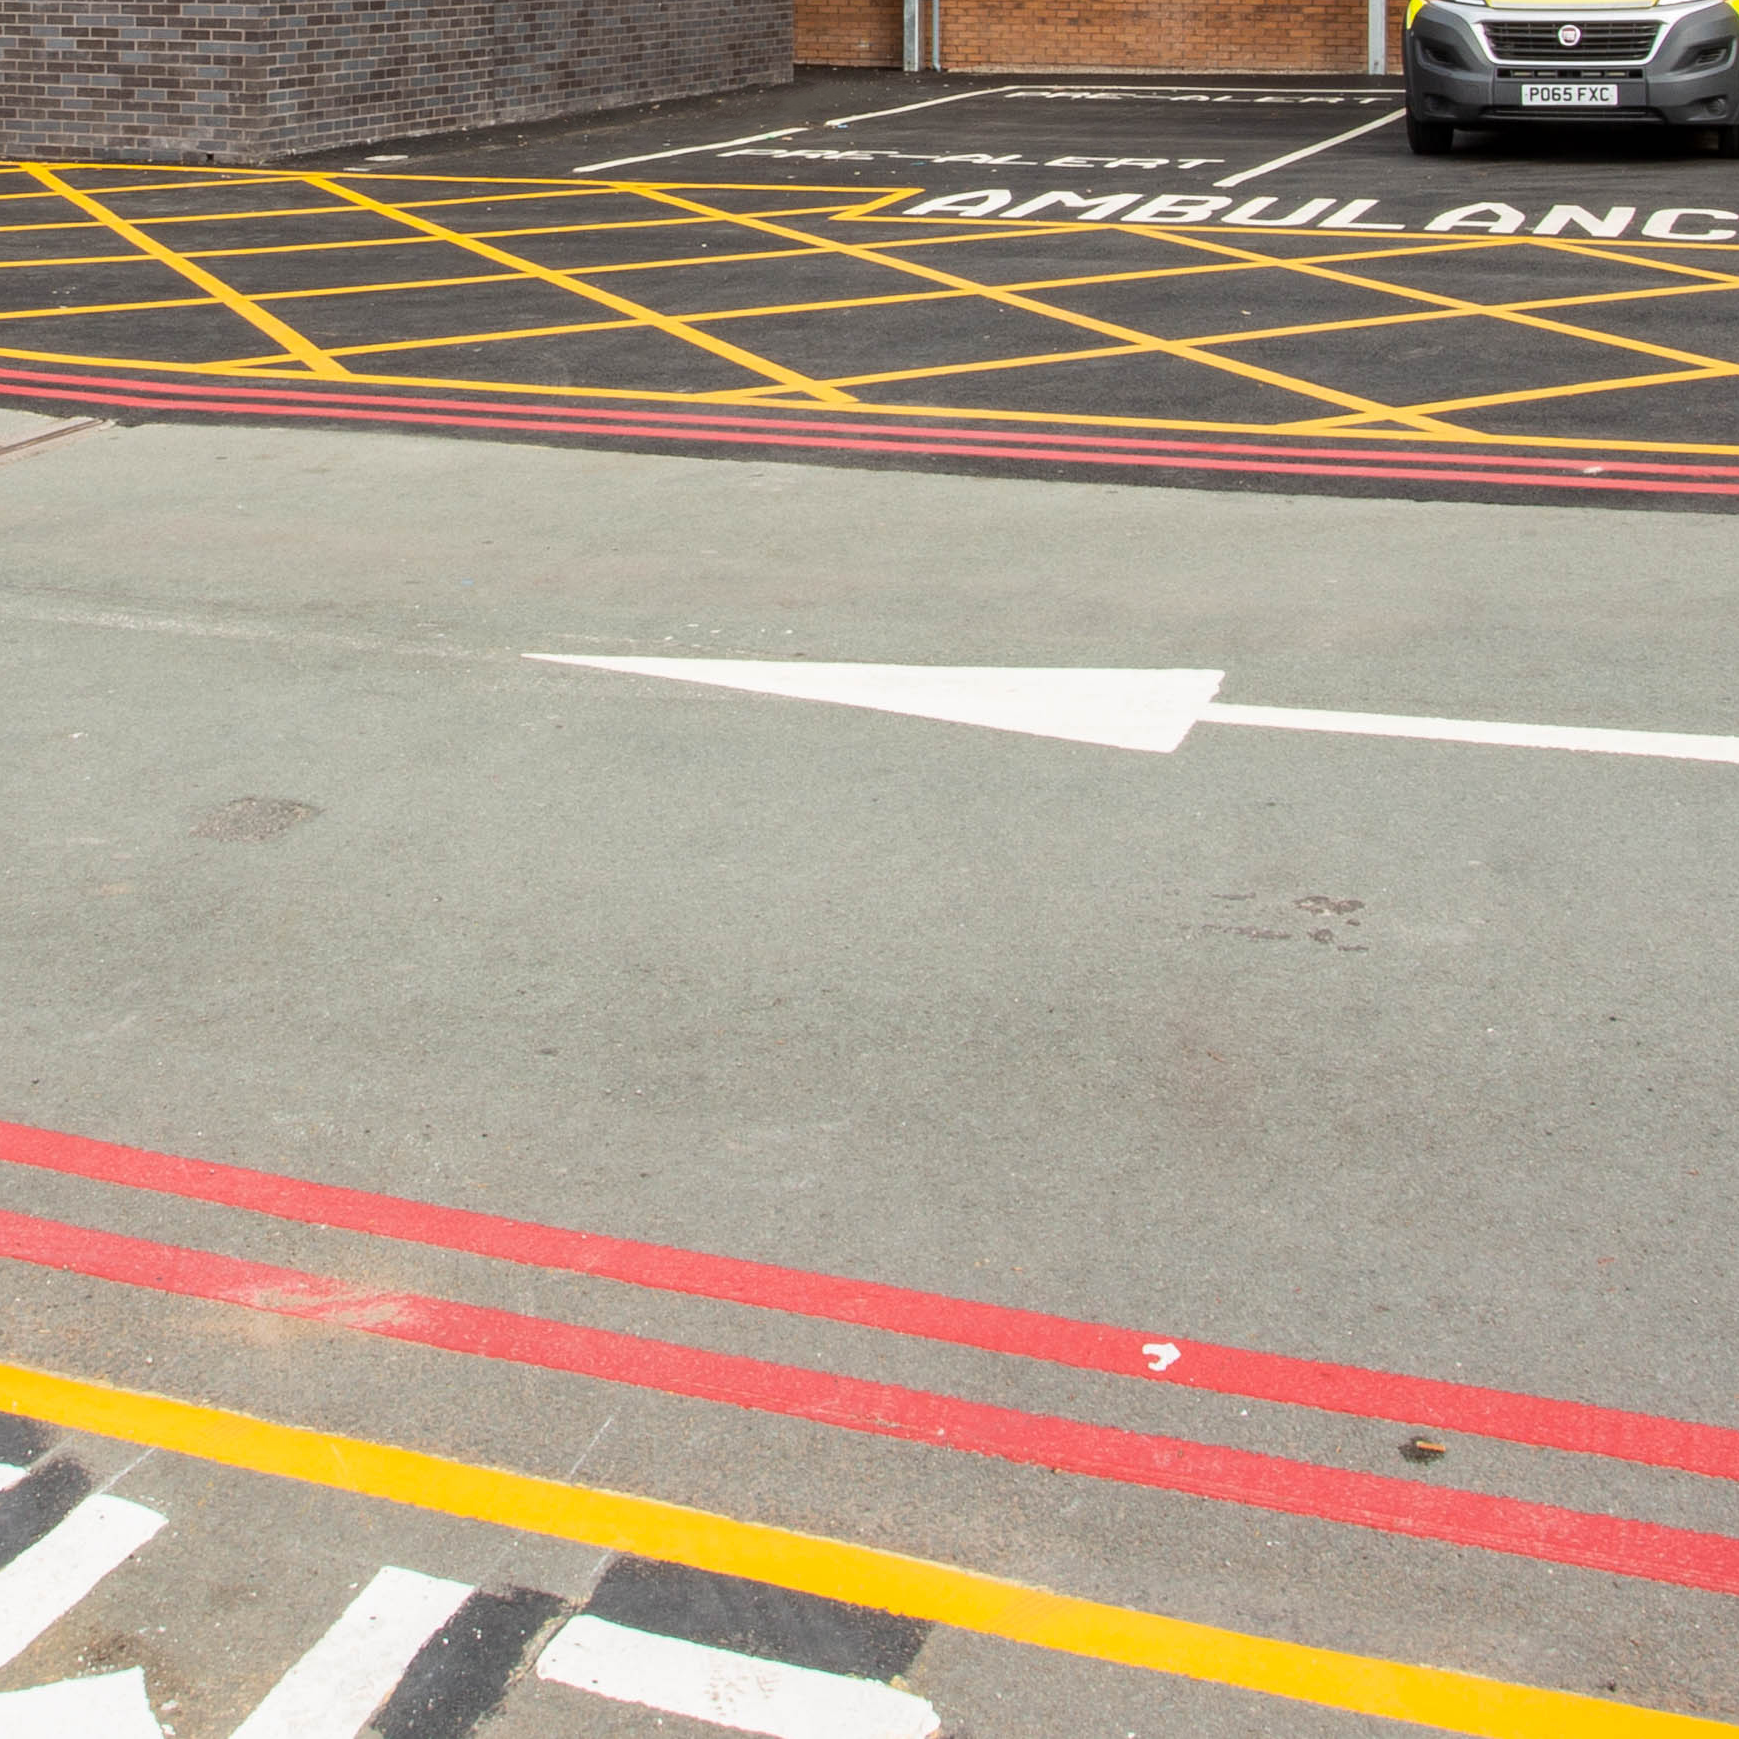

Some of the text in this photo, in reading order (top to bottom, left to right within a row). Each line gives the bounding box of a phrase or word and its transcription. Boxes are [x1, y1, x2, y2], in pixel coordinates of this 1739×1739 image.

[1005, 91, 1393, 103] PRE-ALERT
[1529, 87, 1610, 101] PO65 FXC
[717, 148, 1226, 169] PRE-ALERT
